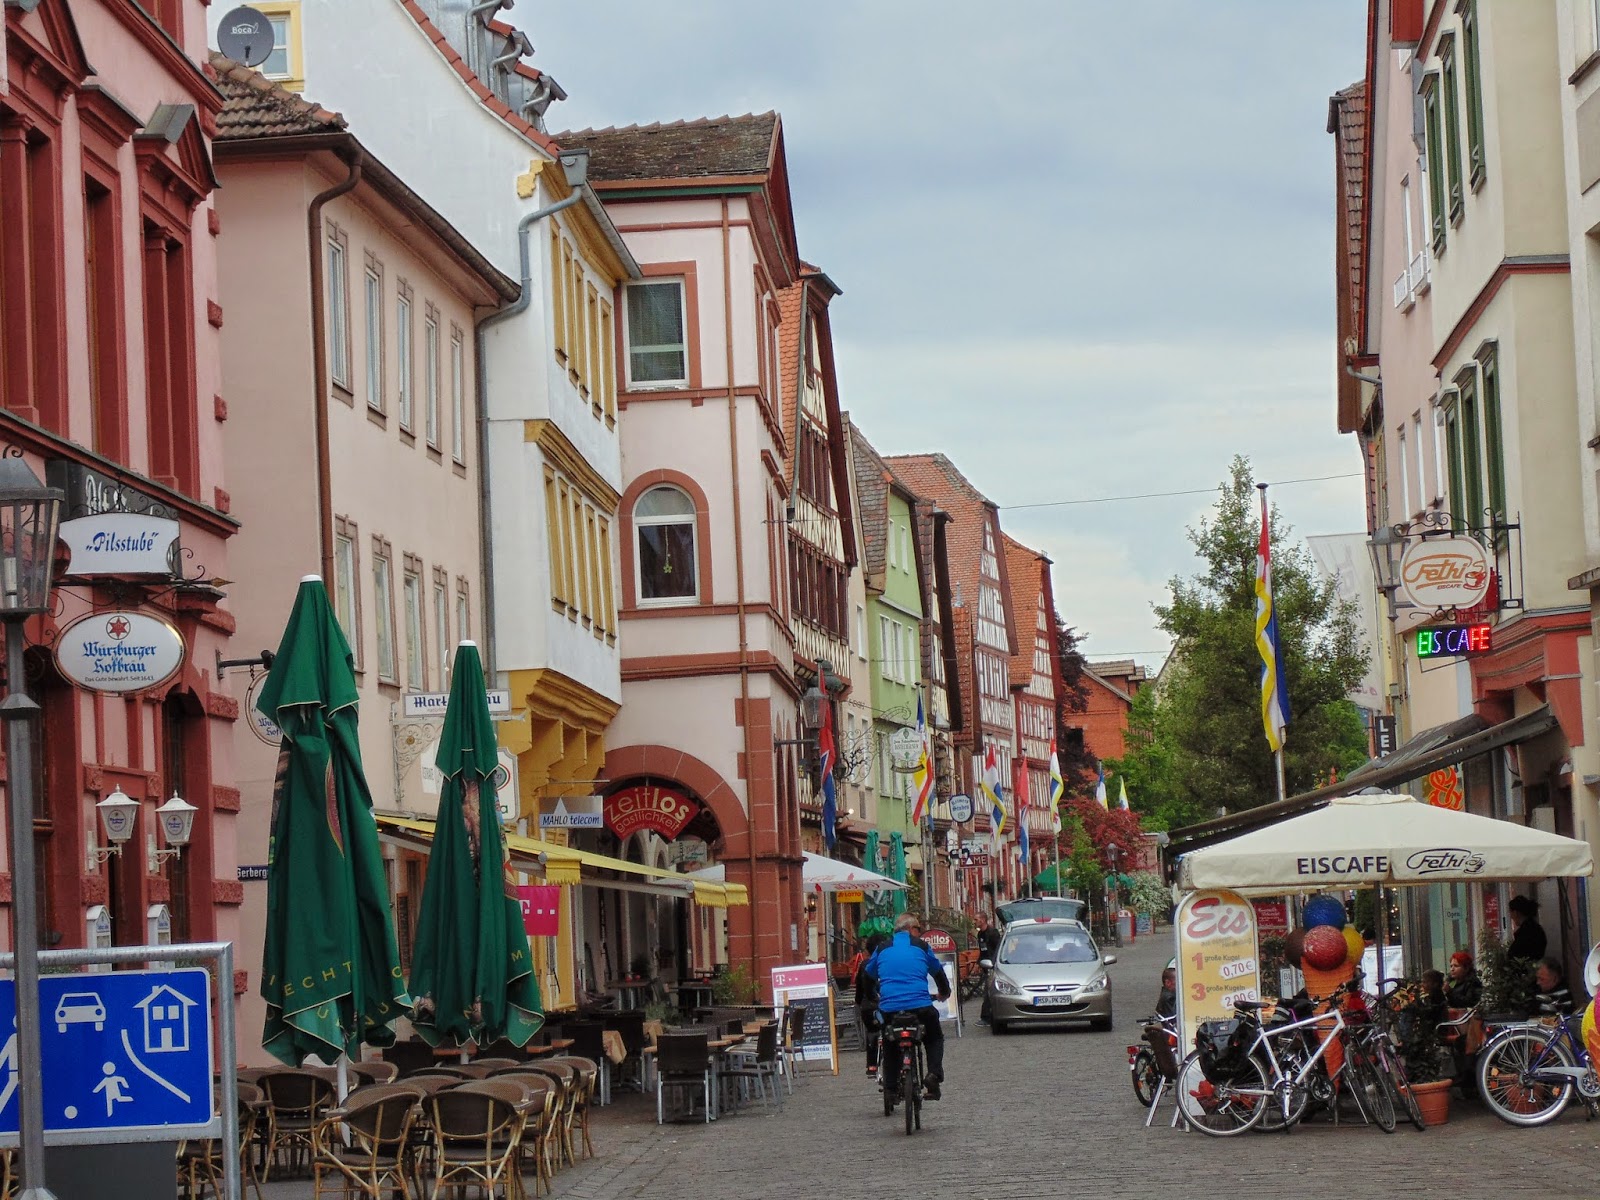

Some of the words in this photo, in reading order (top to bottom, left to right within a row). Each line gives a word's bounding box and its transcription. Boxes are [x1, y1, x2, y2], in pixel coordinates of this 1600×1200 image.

[231, 26, 253, 34] Boca
[82, 641, 157, 660] Würzburger
[92, 657, 147, 674] Hofbräu
[604, 787, 690, 822] zeitlos
[542, 815, 569, 825] MAHLO
[570, 814, 600, 825] telecom
[615, 811, 680, 833] gastlichkeit
[1297, 856, 1388, 875] EISCAFE
[1186, 897, 1250, 939] Eis
[1191, 952, 1204, 971] 1
[1191, 983, 1206, 1002] 3
